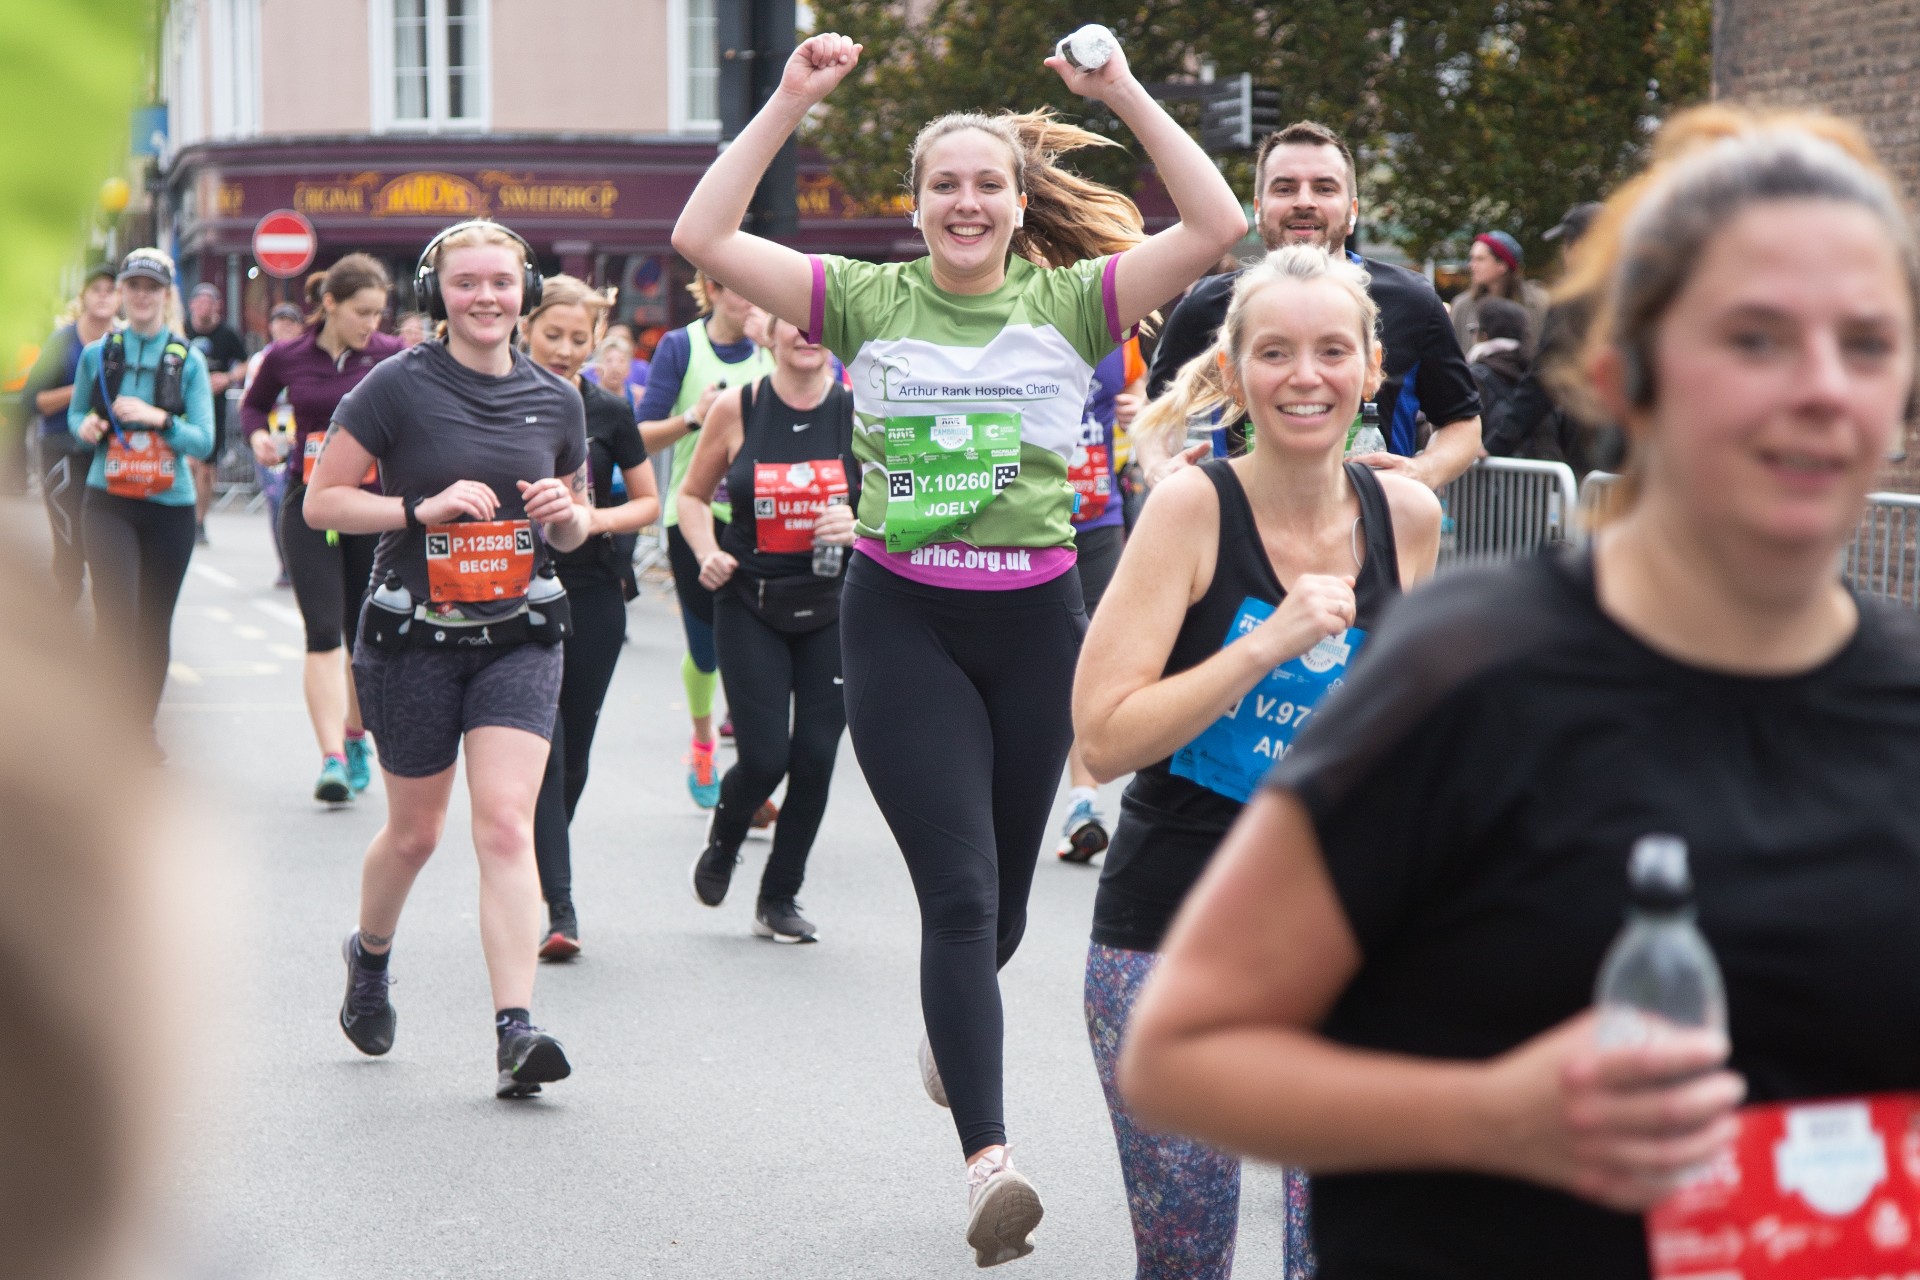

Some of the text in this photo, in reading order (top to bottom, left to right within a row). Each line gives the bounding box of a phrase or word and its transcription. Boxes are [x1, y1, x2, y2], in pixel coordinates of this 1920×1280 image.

[899, 383, 1060, 397] Arthur Rank Hospice Charity
[916, 471, 990, 494] Y.10260
[924, 500, 980, 516] JOELY
[784, 518, 815, 531] EMM
[452, 534, 513, 553] P.12528
[459, 558, 508, 573] BECKS
[910, 545, 1031, 572] arhc.org.uk
